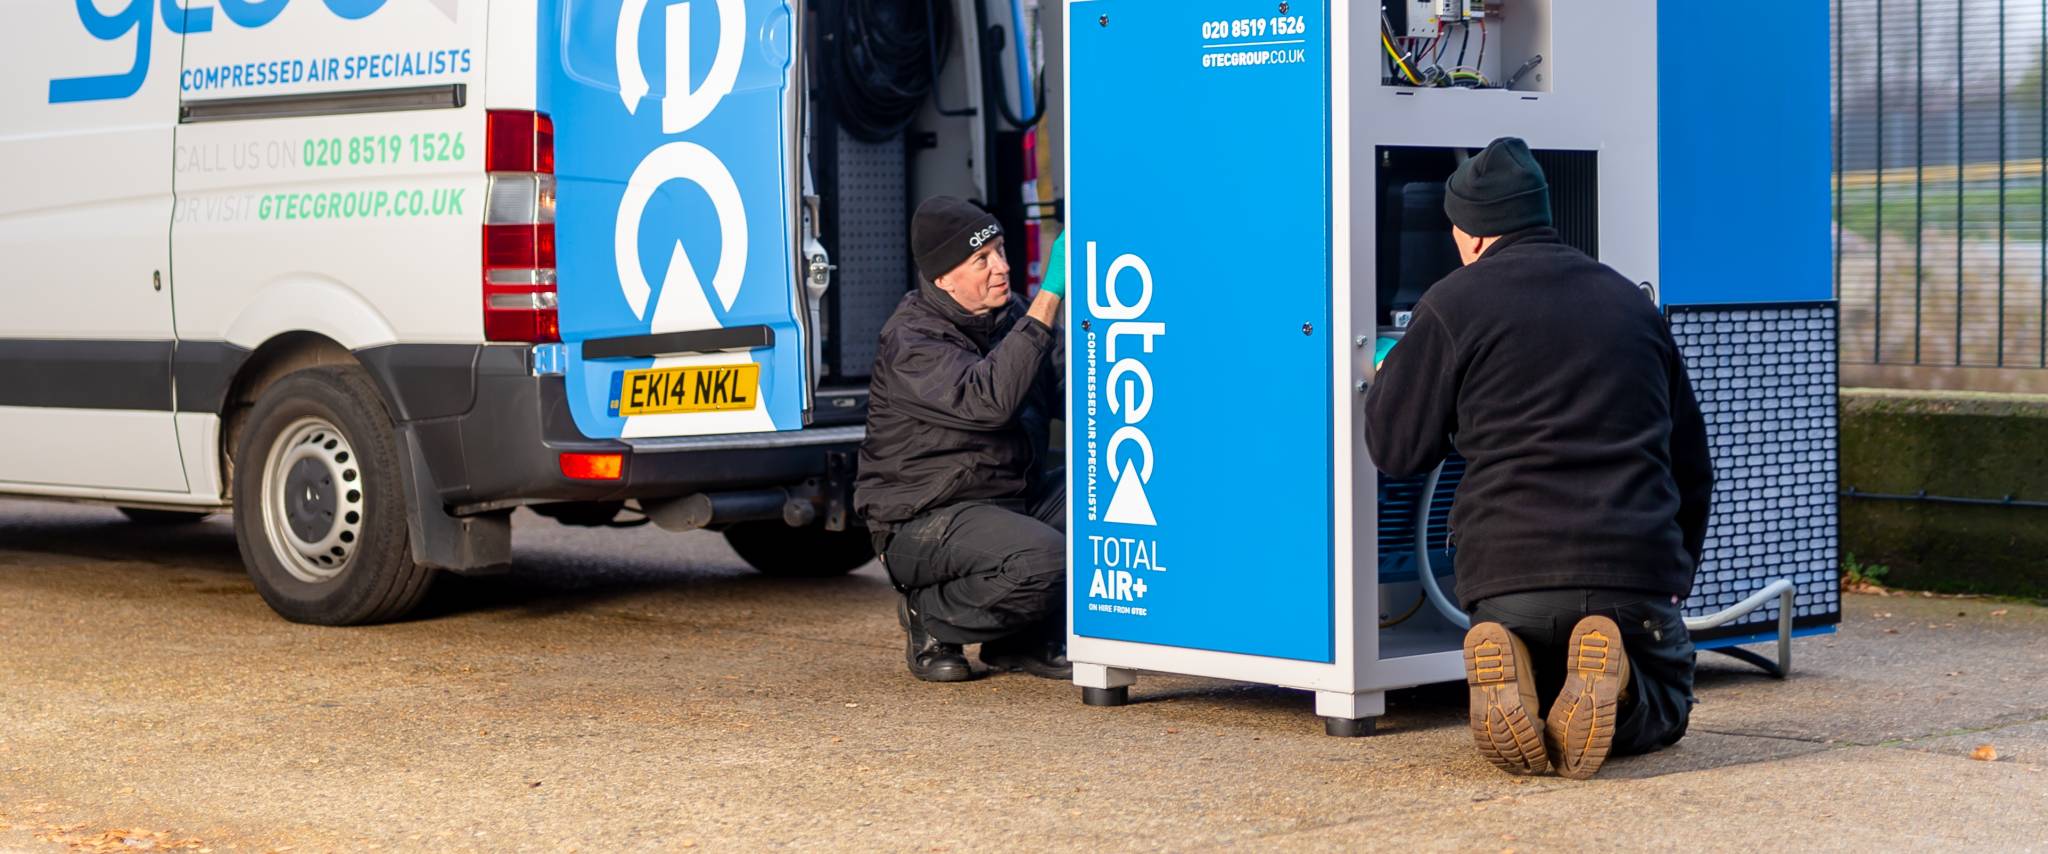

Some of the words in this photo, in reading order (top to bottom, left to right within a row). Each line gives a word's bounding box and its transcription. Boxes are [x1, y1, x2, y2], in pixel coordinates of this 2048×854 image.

[1202, 21, 1229, 39] 020
[1231, 18, 1267, 38] 8519
[1269, 15, 1306, 36] 1526
[181, 58, 304, 91] COMPRESSED
[307, 57, 340, 82] AIR
[343, 48, 471, 80] SPECIALISTS
[1202, 48, 1306, 68] GTECGROUP.CO.UK
[175, 143, 227, 173] CALL
[232, 141, 261, 170] US
[266, 138, 297, 169] ON
[303, 138, 342, 167] 020
[348, 134, 402, 165] 8519
[410, 131, 466, 163] 1526
[174, 196, 201, 223] OR
[205, 193, 255, 222] VISIT
[258, 188, 465, 220] GTECGROUP.CO.UK
[1086, 240, 1167, 485] gtec
[1086, 331, 1097, 416] COMPRESSED
[630, 371, 686, 408] EK14
[694, 369, 747, 405] NKL
[1087, 417, 1097, 440] AIR
[1087, 441, 1097, 521] SPECIALISTS
[1088, 535, 1167, 572] TOTAL
[1088, 568, 1148, 602] AIR+
[1088, 603, 1098, 611] ON
[1098, 604, 1113, 613] HIRE
[1114, 605, 1131, 615] FROM
[1131, 607, 1147, 616] GTEC
